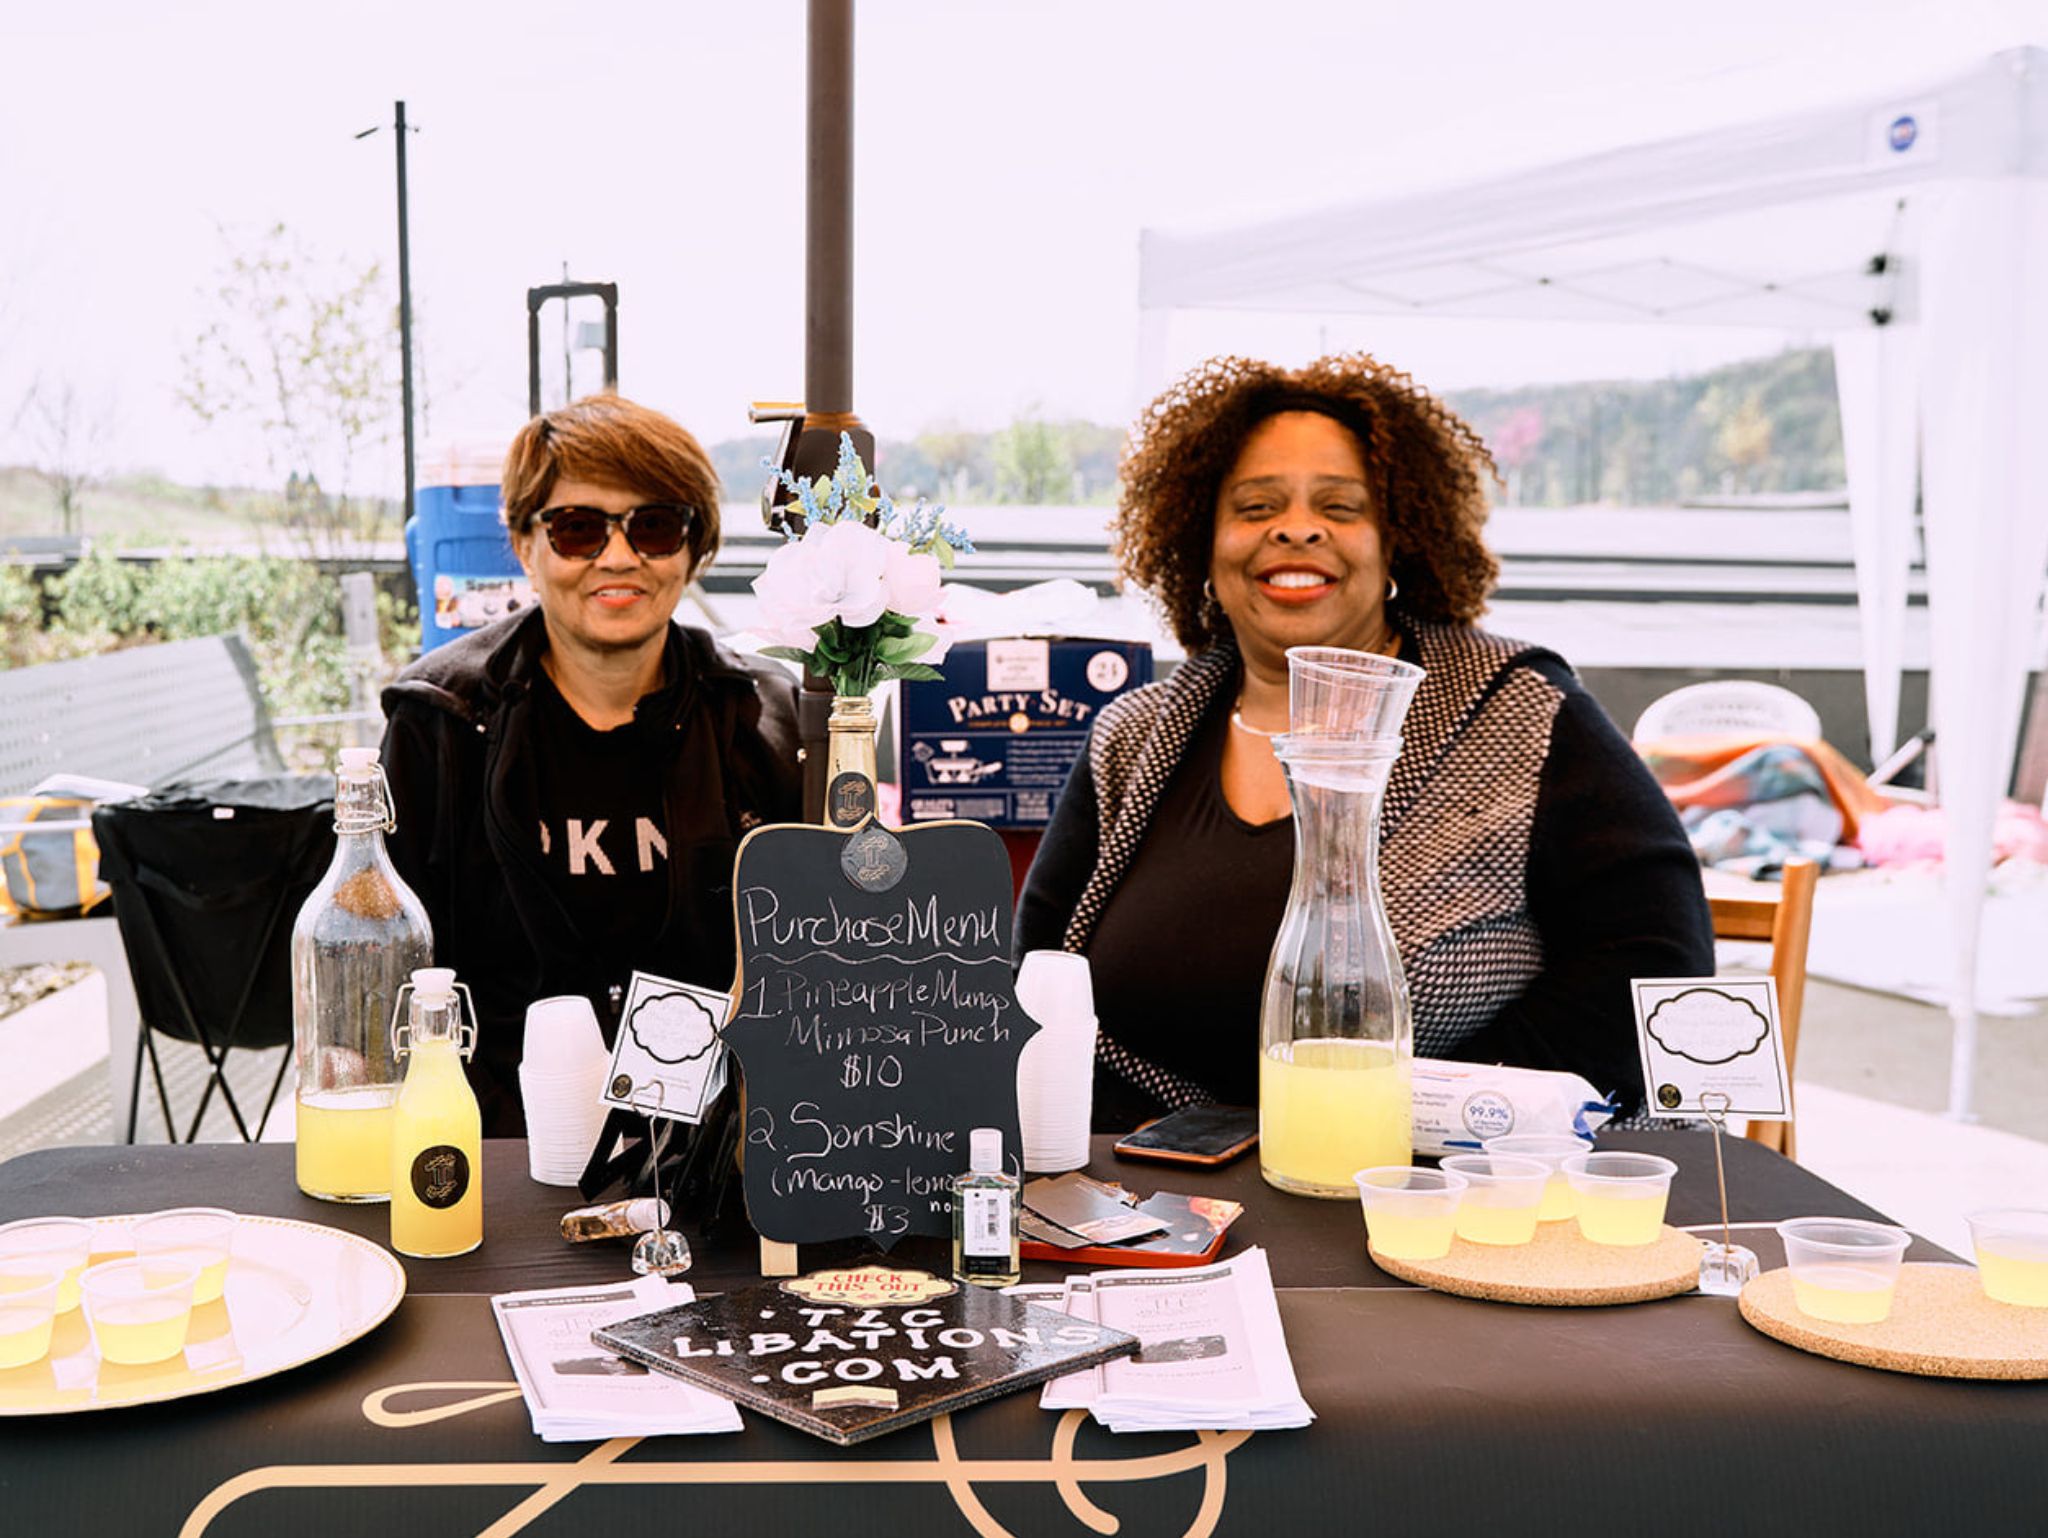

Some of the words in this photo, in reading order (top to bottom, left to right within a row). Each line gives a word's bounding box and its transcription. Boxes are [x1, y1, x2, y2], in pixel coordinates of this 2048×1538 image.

[947, 693, 1030, 723] PARTY
[1039, 688, 1092, 721] SET
[741, 886, 904, 947] Purchase
[907, 894, 1000, 947] Menu
[776, 970, 929, 1013] Pineapple
[931, 969, 1010, 1020] Mango
[785, 1013, 911, 1055] Mimosa
[911, 1011, 1010, 1047] Punch
[840, 1053, 903, 1089] $10
[787, 1101, 955, 1162] Sonshine
[864, 1203, 910, 1234] $3
[816, 1282, 865, 1292] THIS
[880, 1282, 919, 1292] OUT
[833, 1273, 903, 1283] CHECK
[672, 1327, 1100, 1358] LIBATIONS
[750, 1356, 961, 1385] .COM
